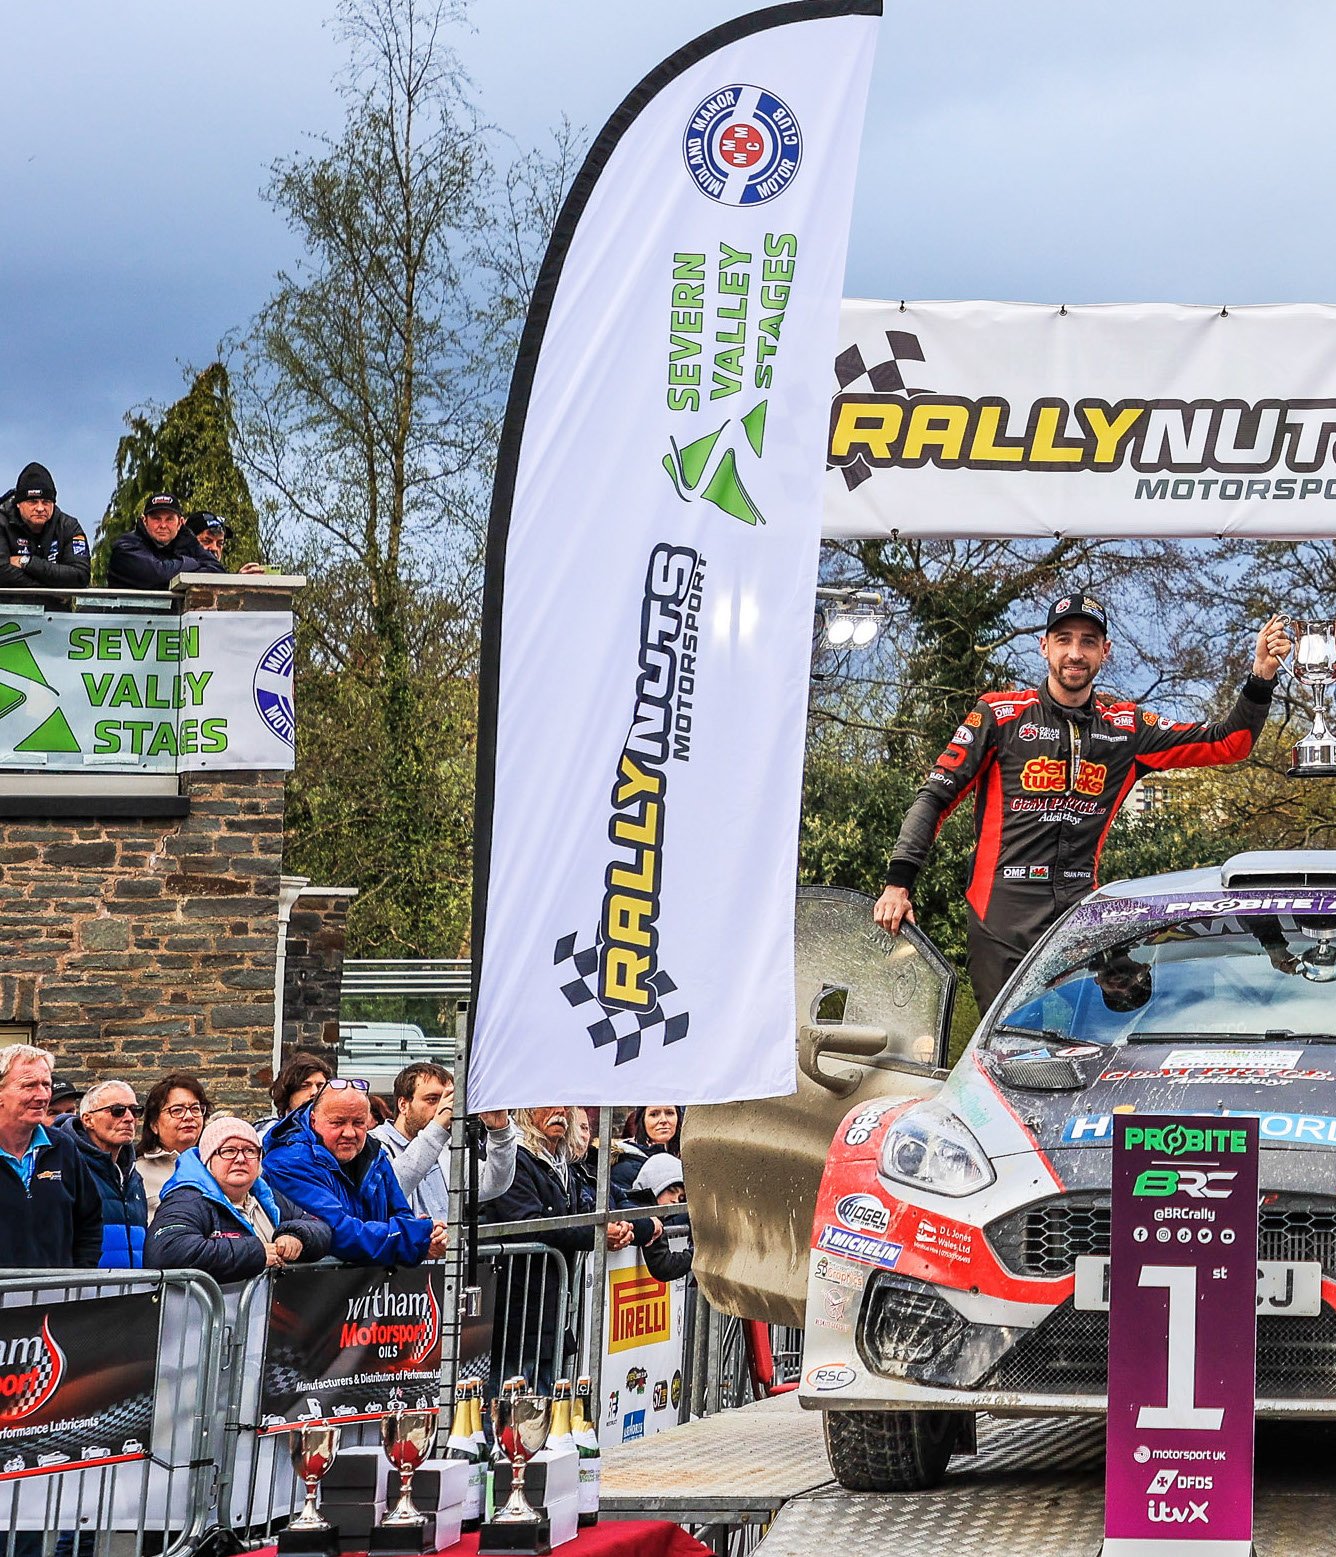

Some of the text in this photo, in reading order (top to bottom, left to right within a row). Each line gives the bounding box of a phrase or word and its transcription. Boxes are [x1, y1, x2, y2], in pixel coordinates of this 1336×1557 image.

[687, 89, 735, 196] MIDLAND MANOR
[756, 107, 798, 200] MOTOR CLUB
[710, 242, 752, 401] VALLEY
[755, 233, 797, 389] STAGES
[669, 253, 706, 411] SEVERN
[673, 554, 707, 761] MOTORSPORT
[994, 707, 1015, 717] OMP
[1113, 717, 1134, 726] OMP
[602, 546, 697, 1008] RALLYNUTS
[1165, 898, 1314, 913] PROBITE
[1125, 1125, 1247, 1155] PROBITE
[1132, 1171, 1238, 1198] BRC
[1154, 1207, 1215, 1222] @BRCrally
[830, 1232, 900, 1260] MICHELIN
[938, 1238, 970, 1253] Wales Ltd
[952, 1230, 971, 1242] Jones
[346, 1283, 428, 1321] witham
[613, 1277, 666, 1341] PIRELLI
[340, 1322, 427, 1349] Motorsport
[1135, 1265, 1228, 1430] 1 st
[379, 1346, 398, 1359] OILS
[296, 1377, 353, 1392] Manufacturers
[354, 1376, 360, 1384] &
[361, 1372, 394, 1383] Distributors
[395, 1370, 403, 1381] of
[816, 1371, 847, 1381] RSC
[50, 1416, 100, 1431] Lubricants
[1153, 1448, 1226, 1461] motorsport UK
[1178, 1477, 1213, 1490] DFDS
[1148, 1501, 1209, 1523] itvX
